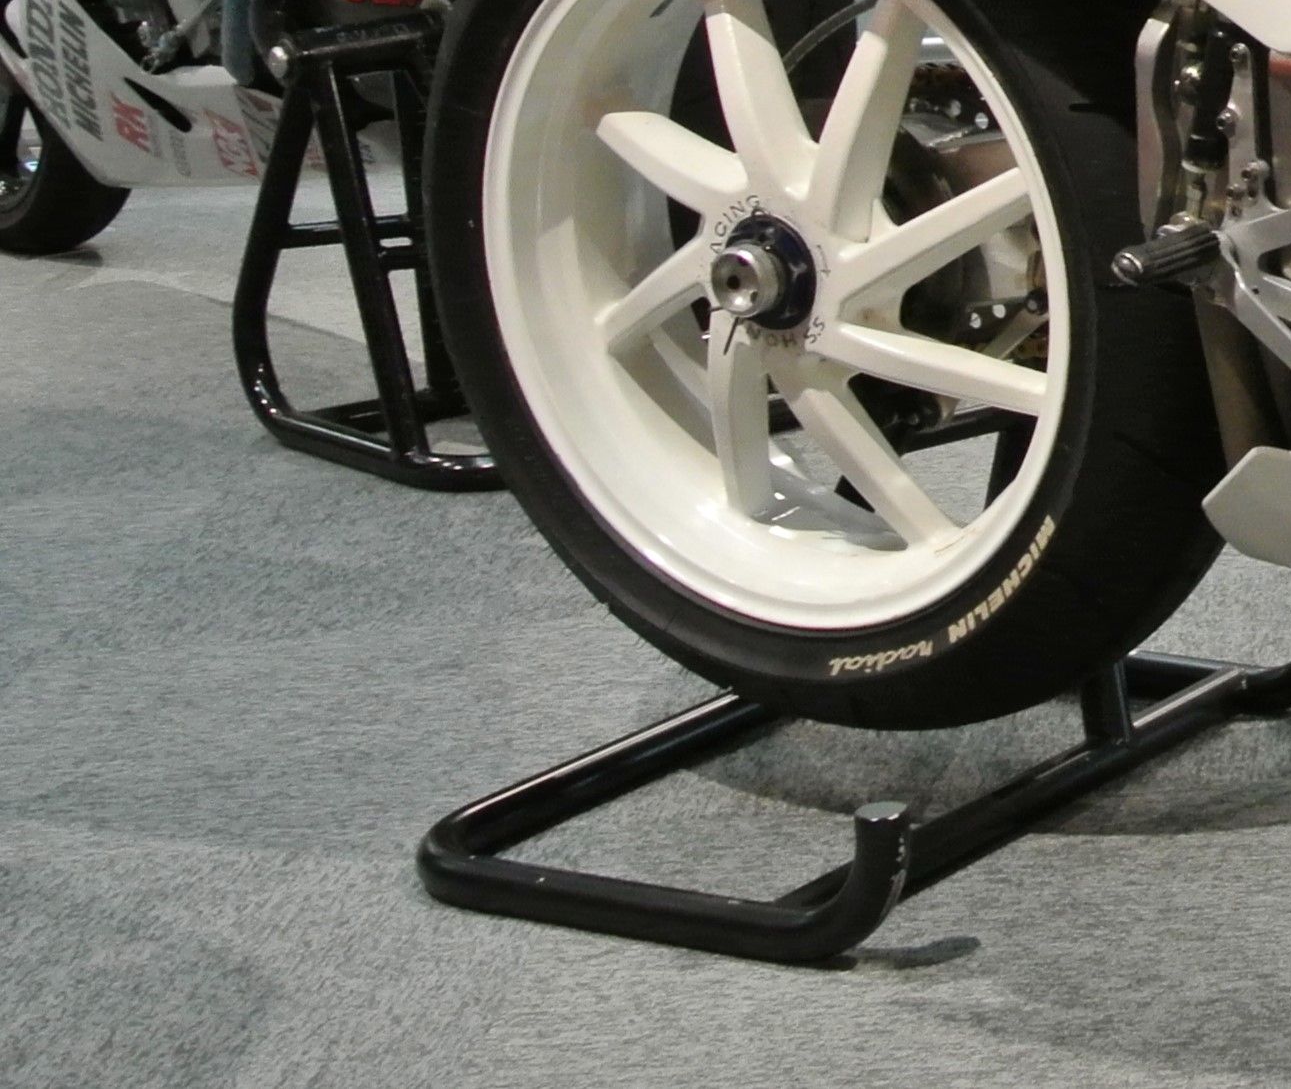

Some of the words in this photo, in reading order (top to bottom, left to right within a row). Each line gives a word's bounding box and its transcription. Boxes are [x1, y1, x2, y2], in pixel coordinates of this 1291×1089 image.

[58, 0, 103, 142] MICHELIN
[711, 194, 760, 256] ACING
[949, 514, 1056, 644] MICHELIN
